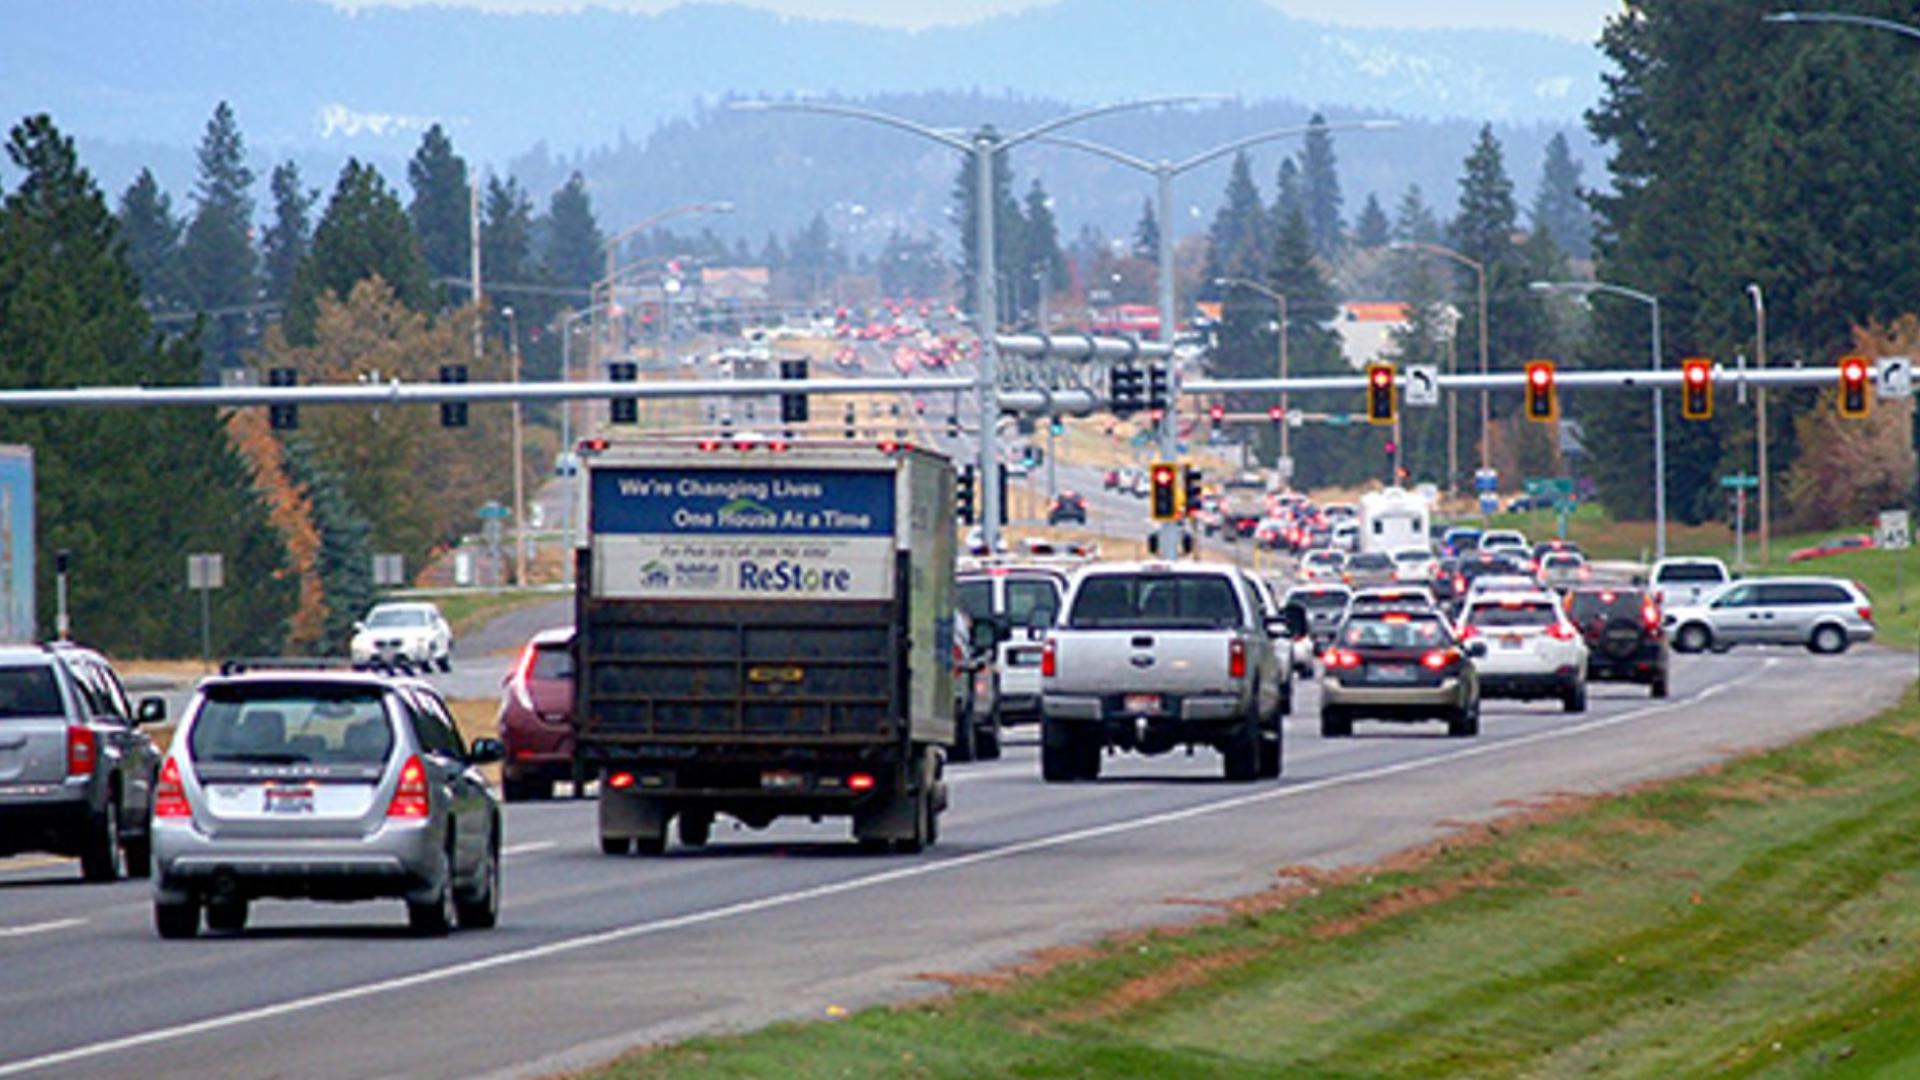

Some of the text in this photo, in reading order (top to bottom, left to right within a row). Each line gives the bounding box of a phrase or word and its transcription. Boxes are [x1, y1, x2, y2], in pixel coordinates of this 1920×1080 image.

[618, 478, 823, 500] We're Changing Lives
[672, 508, 871, 528] One House At a Time
[739, 560, 851, 592] ReStore
